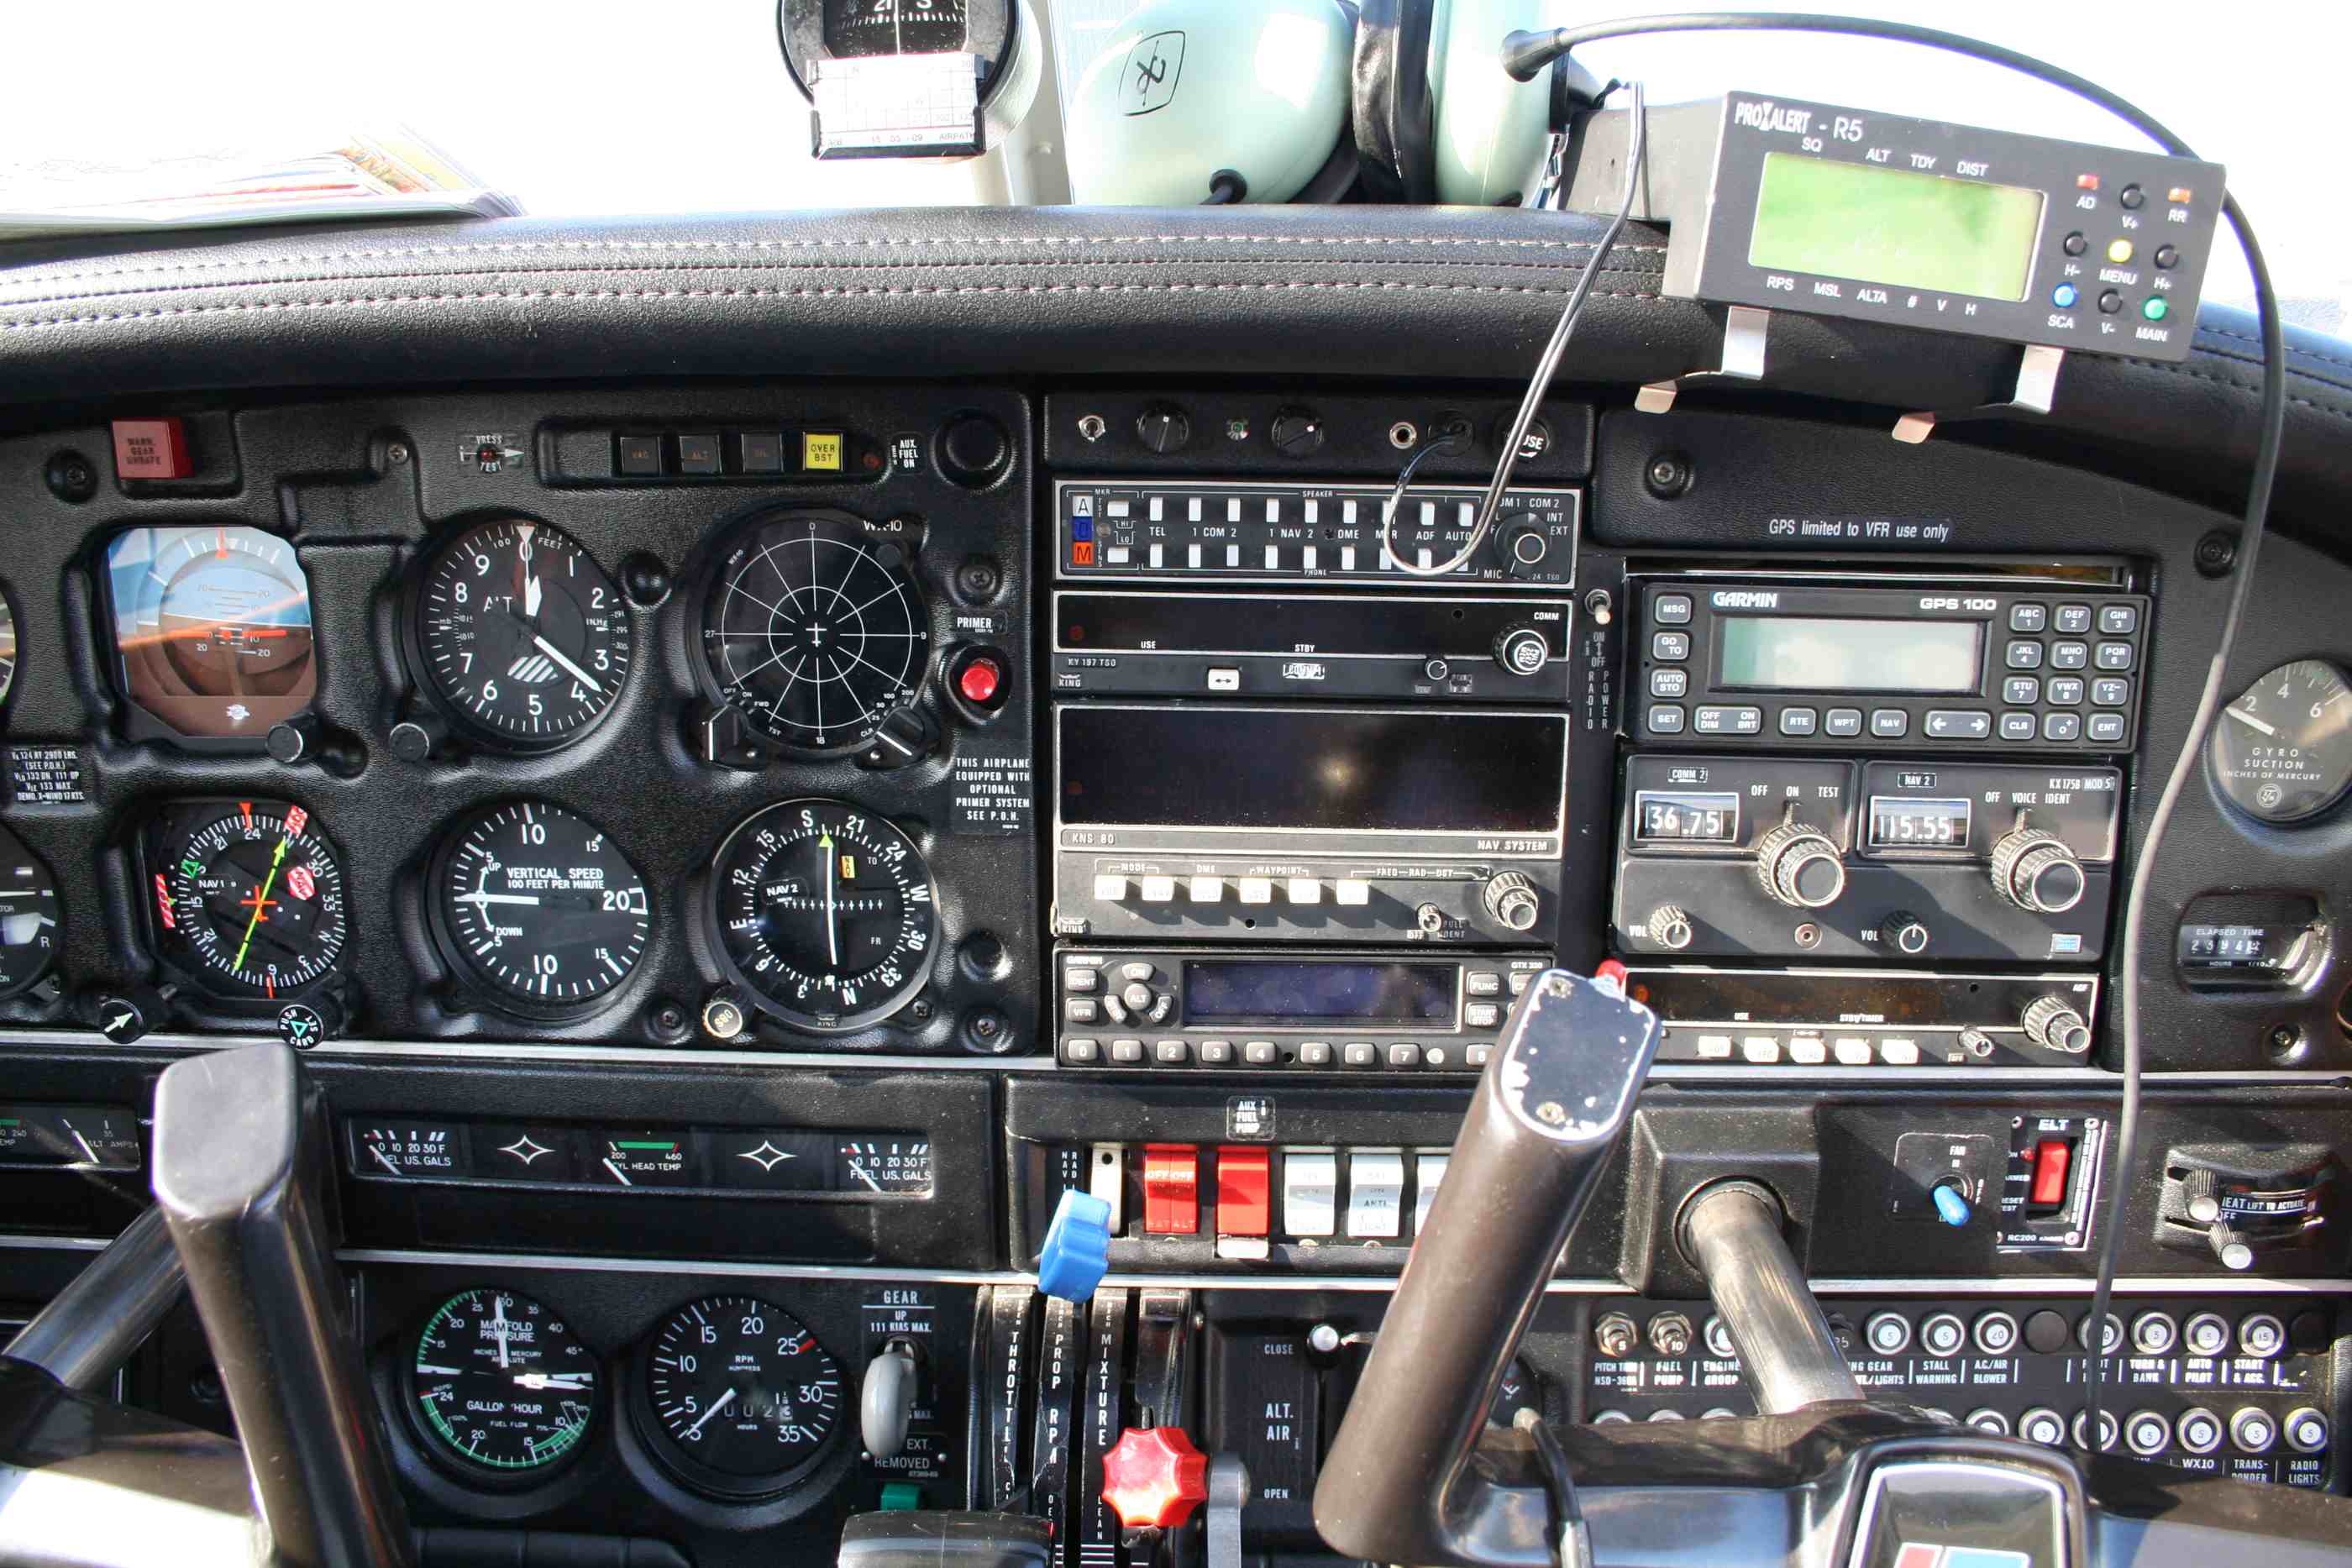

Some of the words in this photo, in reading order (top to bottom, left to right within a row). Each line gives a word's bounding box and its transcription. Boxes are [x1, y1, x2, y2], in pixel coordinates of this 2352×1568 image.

[1833, 118, 1863, 141] R5
[1802, 137, 1822, 152] SQ
[1866, 148, 1892, 163] ALT
[1910, 155, 1935, 169] TDY
[1957, 161, 1988, 176] DIST
[2076, 197, 2097, 209] AD
[2168, 209, 2187, 223] RR
[2099, 269, 2138, 285] MENU
[1767, 275, 1794, 291] RPS
[1814, 282, 1841, 296] MSL
[1857, 289, 1887, 304] ALTA
[2048, 314, 2076, 328] SCA
[2135, 327, 2168, 342] MAIN
[476, 435, 503, 444] PRESS
[811, 443, 836, 454] OVER
[898, 449, 919, 459] FUEL
[814, 454, 833, 463] BST
[1530, 498, 1550, 507] COM
[1150, 527, 1166, 536] TEL
[1204, 527, 1225, 537] COM
[1280, 528, 1301, 538] NAV
[1416, 532, 1435, 540] ADF
[1769, 519, 1795, 534] GPS
[1802, 520, 1840, 536] limited
[1847, 523, 1859, 537] to
[1866, 522, 1890, 538] VFR
[1896, 527, 1917, 538] use
[1923, 523, 1949, 542] only
[475, 554, 490, 576] 9
[1483, 569, 1502, 579] MIC
[454, 582, 468, 603] 8
[591, 588, 605, 609] 2
[1713, 592, 1777, 607] GARMIN
[1663, 605, 1686, 613] MSG
[1920, 598, 1958, 609] GPS
[1963, 599, 1997, 611] 100
[1534, 612, 1559, 621] COMM
[2019, 610, 2040, 618] ABC
[2065, 611, 2085, 619] DEF
[957, 616, 992, 629] PRIMER
[1294, 644, 1315, 653] STBY
[460, 653, 472, 674] 7
[594, 649, 609, 670] 3
[1059, 678, 1081, 687] KING
[1656, 674, 1683, 684] AUTO
[483, 679, 497, 700] 6
[571, 681, 586, 701] 4
[1659, 683, 1680, 692] STO
[2277, 684, 2289, 698] 4
[528, 695, 543, 716] 5
[2245, 696, 2257, 711] 2
[2310, 702, 2322, 717] 6
[1657, 715, 1677, 724] SET
[1701, 711, 1720, 720] OFF
[957, 758, 978, 768] THIS
[983, 758, 1030, 768] AIRPLANE
[2244, 758, 2304, 769] SUCTION
[955, 771, 1002, 782] EQUIPPED
[1006, 771, 1030, 782] WITH
[1672, 769, 1696, 779] COMM
[2276, 772, 2321, 780] MERCURY
[969, 784, 1016, 794] OPTIONAL
[1751, 785, 1768, 796] OFF
[1786, 786, 1799, 797] ON
[1819, 786, 1839, 798] TEST
[956, 796, 991, 808] PRIMER
[995, 797, 1030, 808] SYSTEM
[1985, 792, 2000, 803] OFF
[2013, 792, 2036, 804] VOICE
[2045, 793, 2071, 804] IDENT
[801, 810, 813, 827] S
[966, 810, 985, 821] SEE
[846, 815, 865, 834] 21
[522, 823, 546, 845] 10
[585, 841, 600, 852] 15
[1478, 840, 1499, 850] NAV
[1504, 841, 1547, 851] SYSTEM
[489, 863, 501, 872] UP
[1257, 866, 1302, 874] WAYPOINT
[507, 868, 560, 879] VERTICAL
[569, 868, 604, 879] SPEED
[507, 879, 524, 889] 100
[526, 880, 549, 889] FEET
[552, 880, 570, 889] PER
[572, 880, 605, 889] MINUTE
[910, 884, 930, 901] W
[602, 890, 630, 911] 20
[496, 927, 522, 936] DOWN
[1630, 926, 1647, 937] VOL
[1861, 931, 1878, 941] VOL
[2196, 928, 2237, 936] ELAPSED
[2243, 928, 2265, 936] TIME
[595, 948, 608, 959] 15
[534, 955, 559, 974] 10
[1069, 978, 1095, 986] IDENT
[1473, 983, 1499, 991] FUNC
[1238, 1101, 1256, 1111] AUX
[2038, 1120, 2069, 1130] ELT
[423, 1156, 451, 1167] GALS
[632, 1162, 655, 1171] HEAD
[658, 1163, 681, 1172] TEMP
[902, 1171, 932, 1181] GALS
[884, 1291, 918, 1303] GEAR
[895, 1311, 906, 1321] UP
[450, 1319, 465, 1328] 20
[549, 1324, 564, 1332] 40
[741, 1318, 764, 1335] 20
[870, 1322, 885, 1332] 111
[890, 1322, 909, 1332] KIAS
[701, 1327, 717, 1343] 15
[777, 1338, 798, 1356] 25
[1264, 1345, 1294, 1355] CLOSE
[679, 1356, 697, 1372] 10
[1656, 1361, 1682, 1371] FUEL
[1869, 1361, 1893, 1371] GEAR
[1923, 1361, 1950, 1371] STALL
[2234, 1360, 2265, 1370] START
[1916, 1374, 1957, 1384] WARNING
[1974, 1374, 2007, 1384] BLOWER
[2133, 1373, 2159, 1383] BANK
[2185, 1373, 2213, 1383] PILOT
[799, 1386, 822, 1403] 30
[1098, 1334, 1112, 1446] MIXTURE
[685, 1397, 696, 1413] 5
[778, 1425, 800, 1443] 35
[1267, 1426, 1290, 1441] AIR
[874, 1457, 930, 1468] REMOVED
[2182, 1459, 2214, 1469] WX10
[2291, 1460, 2318, 1470] RADIO
[2289, 1474, 2319, 1484] LIGHTS
[1264, 1489, 1289, 1499] OPEN
